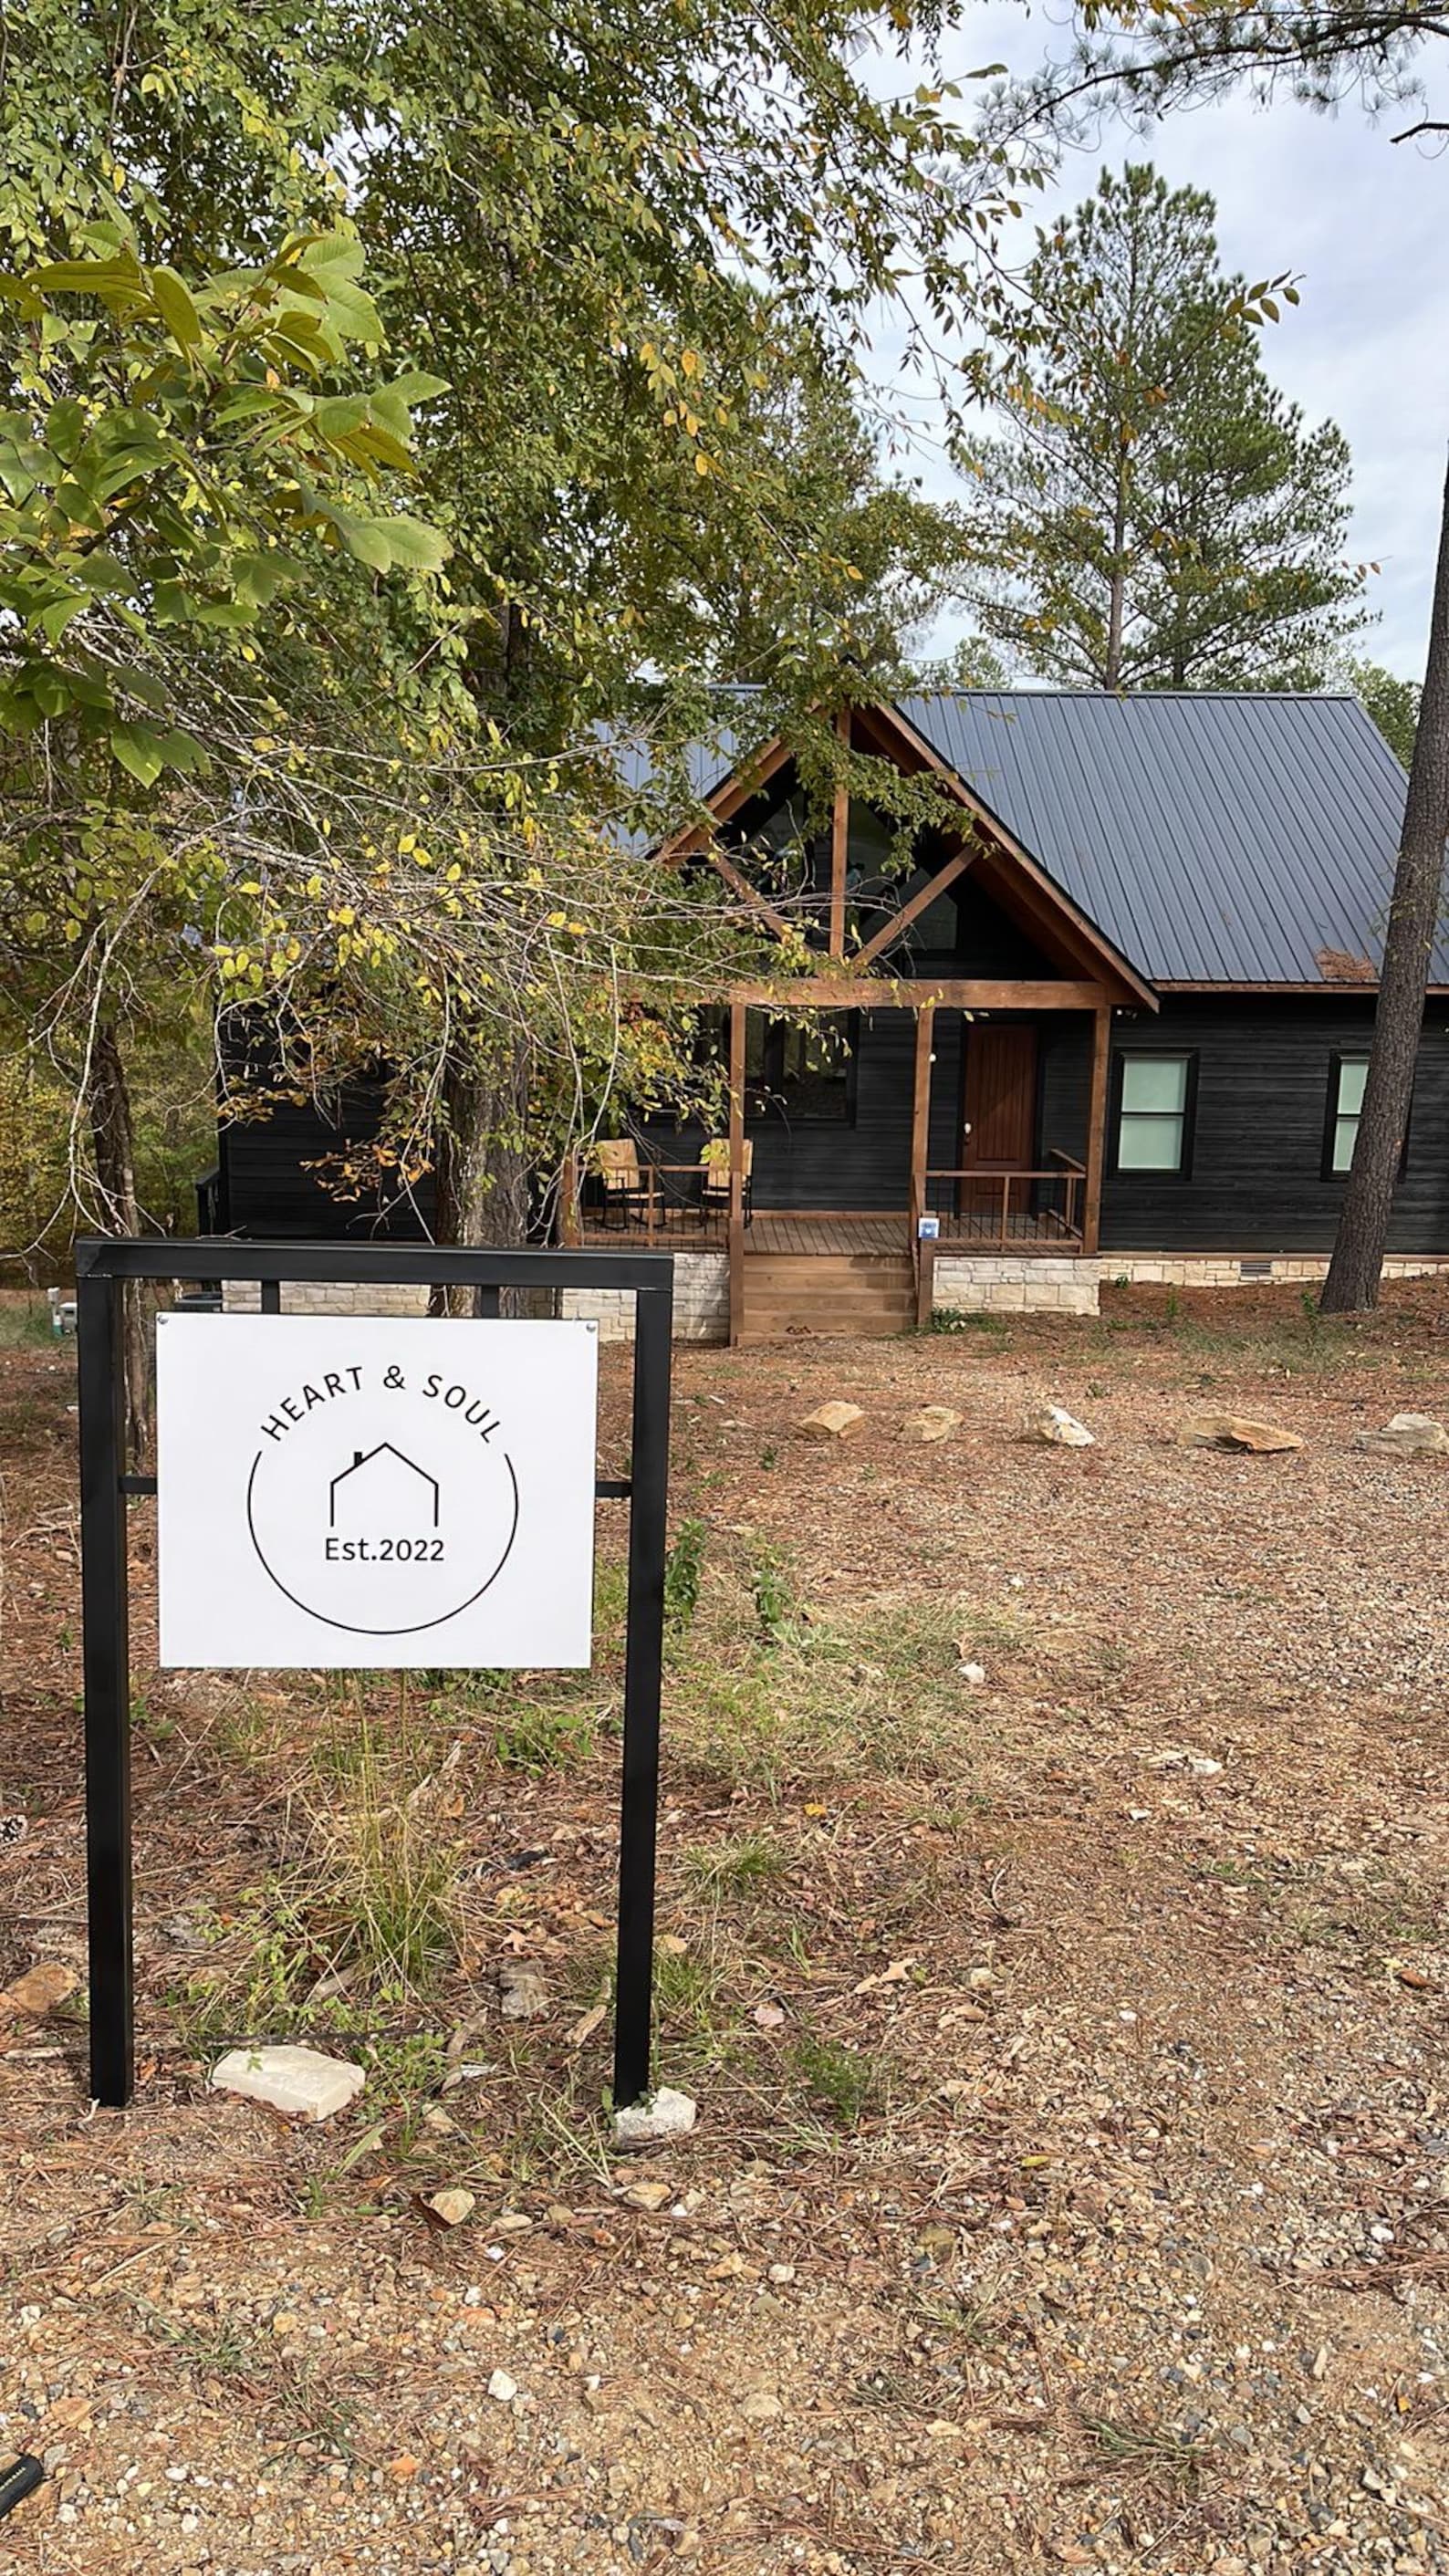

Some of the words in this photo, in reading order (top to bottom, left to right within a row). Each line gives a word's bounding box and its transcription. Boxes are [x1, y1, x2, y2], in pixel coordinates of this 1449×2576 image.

[260, 1366, 363, 1442] HEART
[382, 1365, 406, 1390] &
[422, 1374, 501, 1444] SOUL
[325, 1538, 444, 1561] Est.2022
